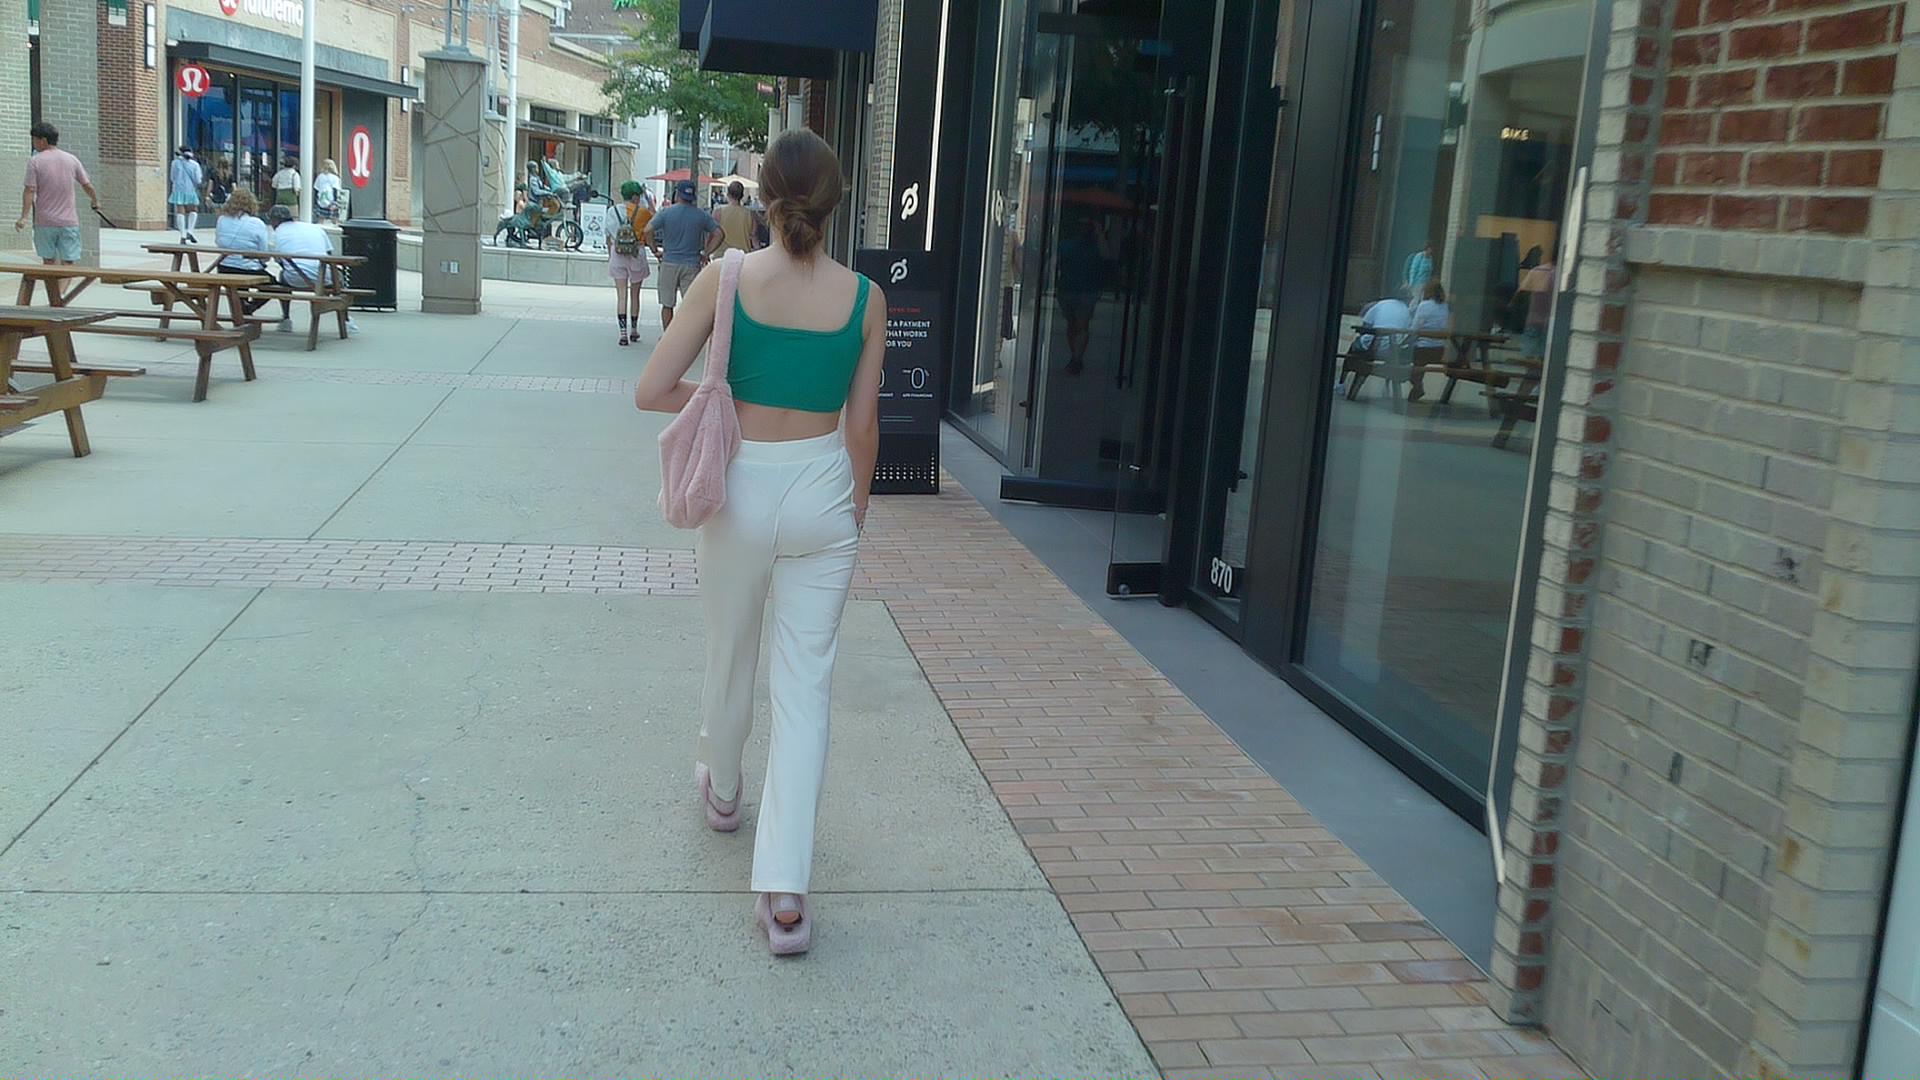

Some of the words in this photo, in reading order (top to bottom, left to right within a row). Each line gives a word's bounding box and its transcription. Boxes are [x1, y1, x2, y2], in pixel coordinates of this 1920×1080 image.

[243, 0, 304, 26] lululemo
[899, 320, 930, 328] PAYMENT
[903, 330, 928, 338] WORKS
[897, 340, 912, 348] YOU
[1210, 556, 1232, 594] 870
